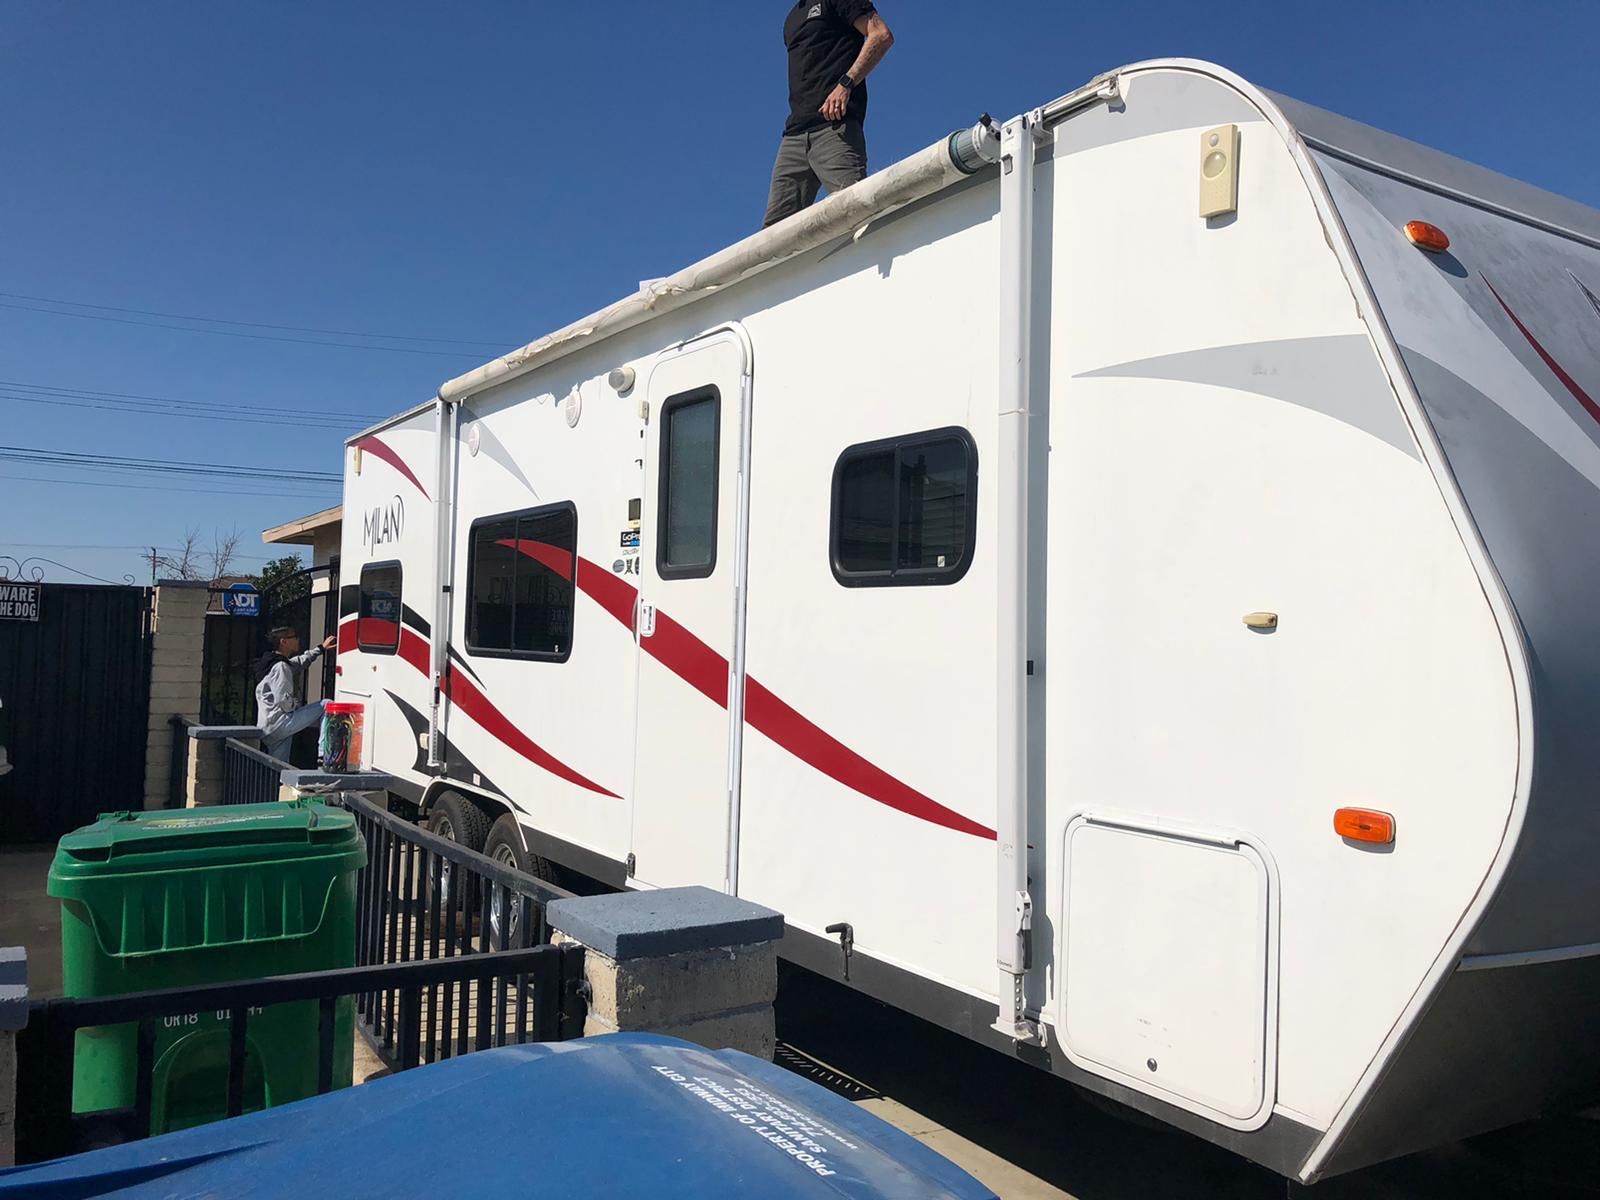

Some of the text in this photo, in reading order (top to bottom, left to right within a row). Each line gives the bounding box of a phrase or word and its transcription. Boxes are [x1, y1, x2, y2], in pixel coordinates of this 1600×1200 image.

[363, 495, 405, 557] MILAN
[14, 602, 37, 617] DOG
[233, 593, 259, 607] ADT
[650, 1065, 837, 1177] PROPERTY OF MIDWAY CITY
[692, 1076, 828, 1153] SANITARY DISTRICT
